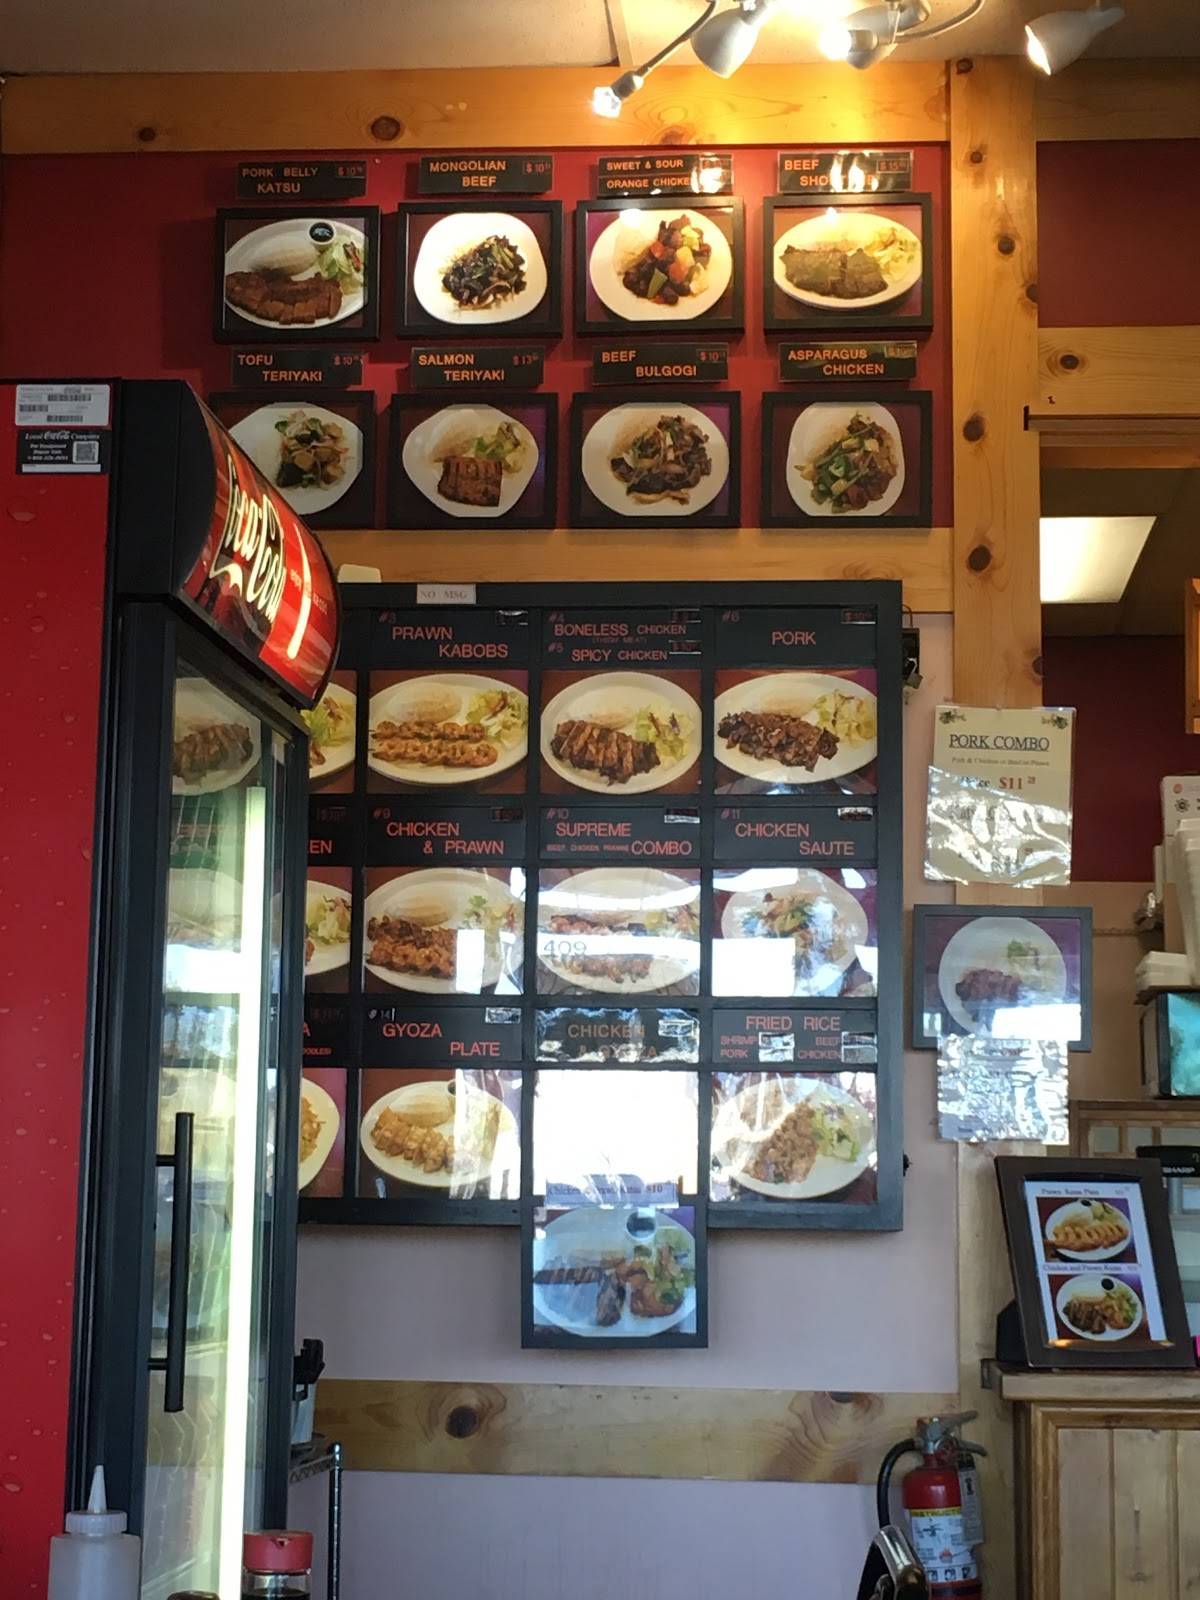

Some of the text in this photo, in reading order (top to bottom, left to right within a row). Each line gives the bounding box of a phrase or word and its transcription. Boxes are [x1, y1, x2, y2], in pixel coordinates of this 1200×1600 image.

[430, 160, 506, 173] MONGOLIAN
[606, 159, 684, 171] SWEET & SOUR
[784, 160, 819, 171] BEEF
[241, 167, 319, 178] PORK BELLY
[257, 182, 301, 194] KATSU
[462, 175, 497, 187] BEEF
[606, 177, 691, 189] ORANGE CHICKE
[237, 354, 274, 366] TOFU
[418, 354, 475, 366] SALMON
[602, 350, 637, 363] BEEF
[788, 348, 868, 361] ASPARAGUS
[262, 370, 322, 382] TERIYAKI
[443, 370, 505, 381] TERIYAKI
[635, 365, 697, 378] BULGOGI
[822, 363, 885, 376] CHICKEN
[420, 590, 468, 599] NO MSG
[392, 626, 453, 641] PRAWN
[554, 623, 687, 637] BONELESS CHICKEN
[771, 631, 817, 646] PORK
[438, 643, 509, 659] KABOBS
[571, 648, 668, 662] SPICY CHICKEN
[949, 734, 1050, 752] PORK COMBO
[998, 776, 1023, 790] $11
[546, 807, 569, 821] #10
[386, 821, 461, 837] CHICKEN
[555, 821, 633, 838] SUPREME
[735, 821, 811, 838] CHICKEN
[422, 840, 505, 855] & PRAWN
[631, 839, 693, 856] COMBO
[799, 840, 856, 856] SAUTE
[383, 1022, 443, 1038] GYOZA
[745, 1015, 841, 1031] FRIED RICE
[567, 1023, 645, 1039] CHICKEN
[449, 1041, 501, 1057] PLATE
[719, 1049, 749, 1059] PORK
